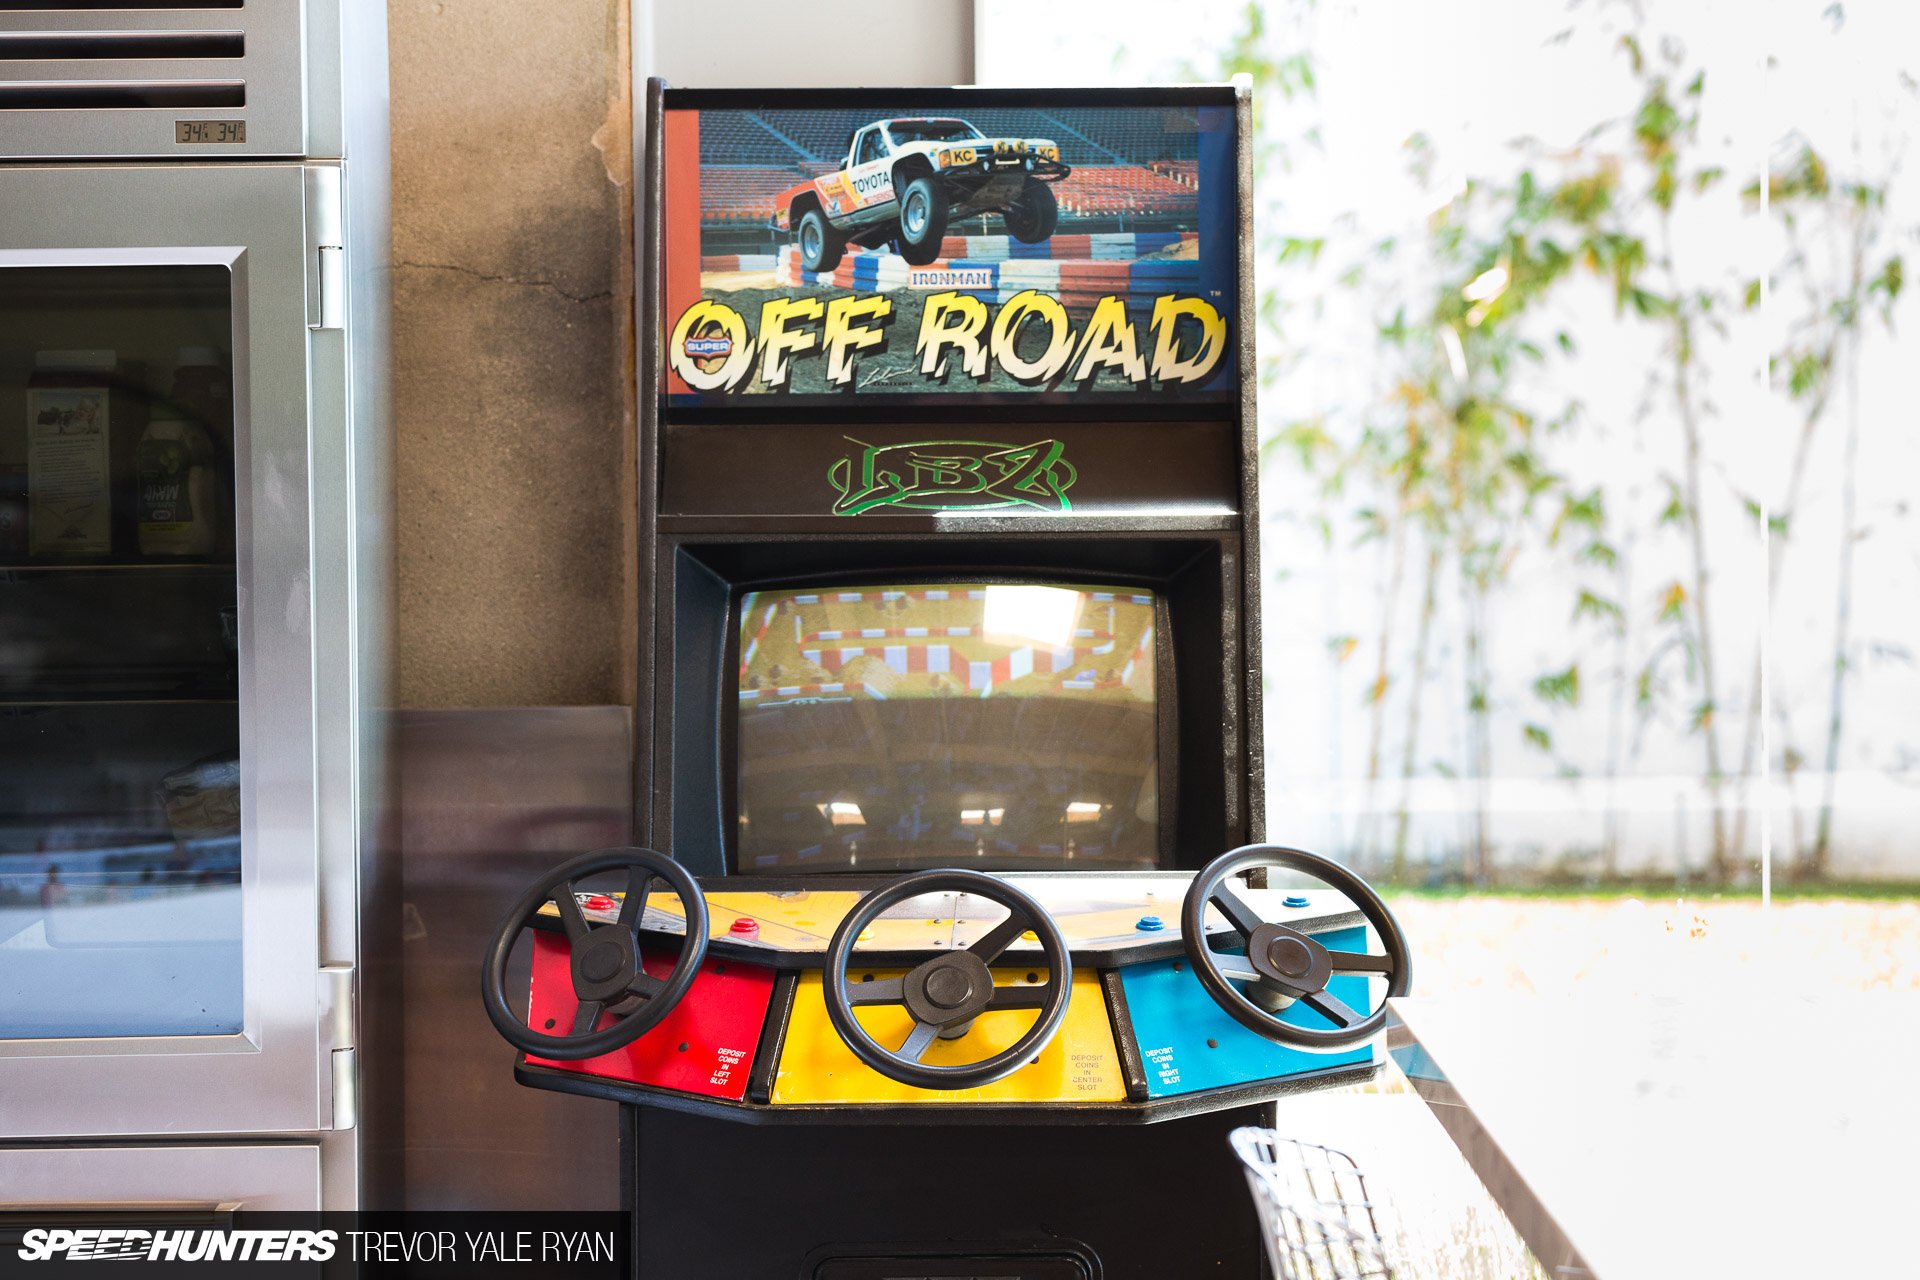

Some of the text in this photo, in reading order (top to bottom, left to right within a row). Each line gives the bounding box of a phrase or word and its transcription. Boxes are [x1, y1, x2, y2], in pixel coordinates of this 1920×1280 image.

[953, 149, 973, 163] KC
[1039, 147, 1055, 160] KC
[852, 171, 891, 194] TOYOTA
[912, 272, 987, 285] IRONMAN
[669, 289, 1228, 392] OFF ROAD
[687, 342, 730, 351] SUPER
[718, 1048, 746, 1058] DEPOSIT
[1145, 1047, 1173, 1057] DEPOSIT
[718, 1055, 739, 1064] COINS
[1152, 1055, 1173, 1063] COINS
[713, 1070, 731, 1078] LEFT
[1158, 1069, 1178, 1077] RIGHT
[710, 1077, 728, 1085] SLOT
[1163, 1076, 1180, 1084] SLOT
